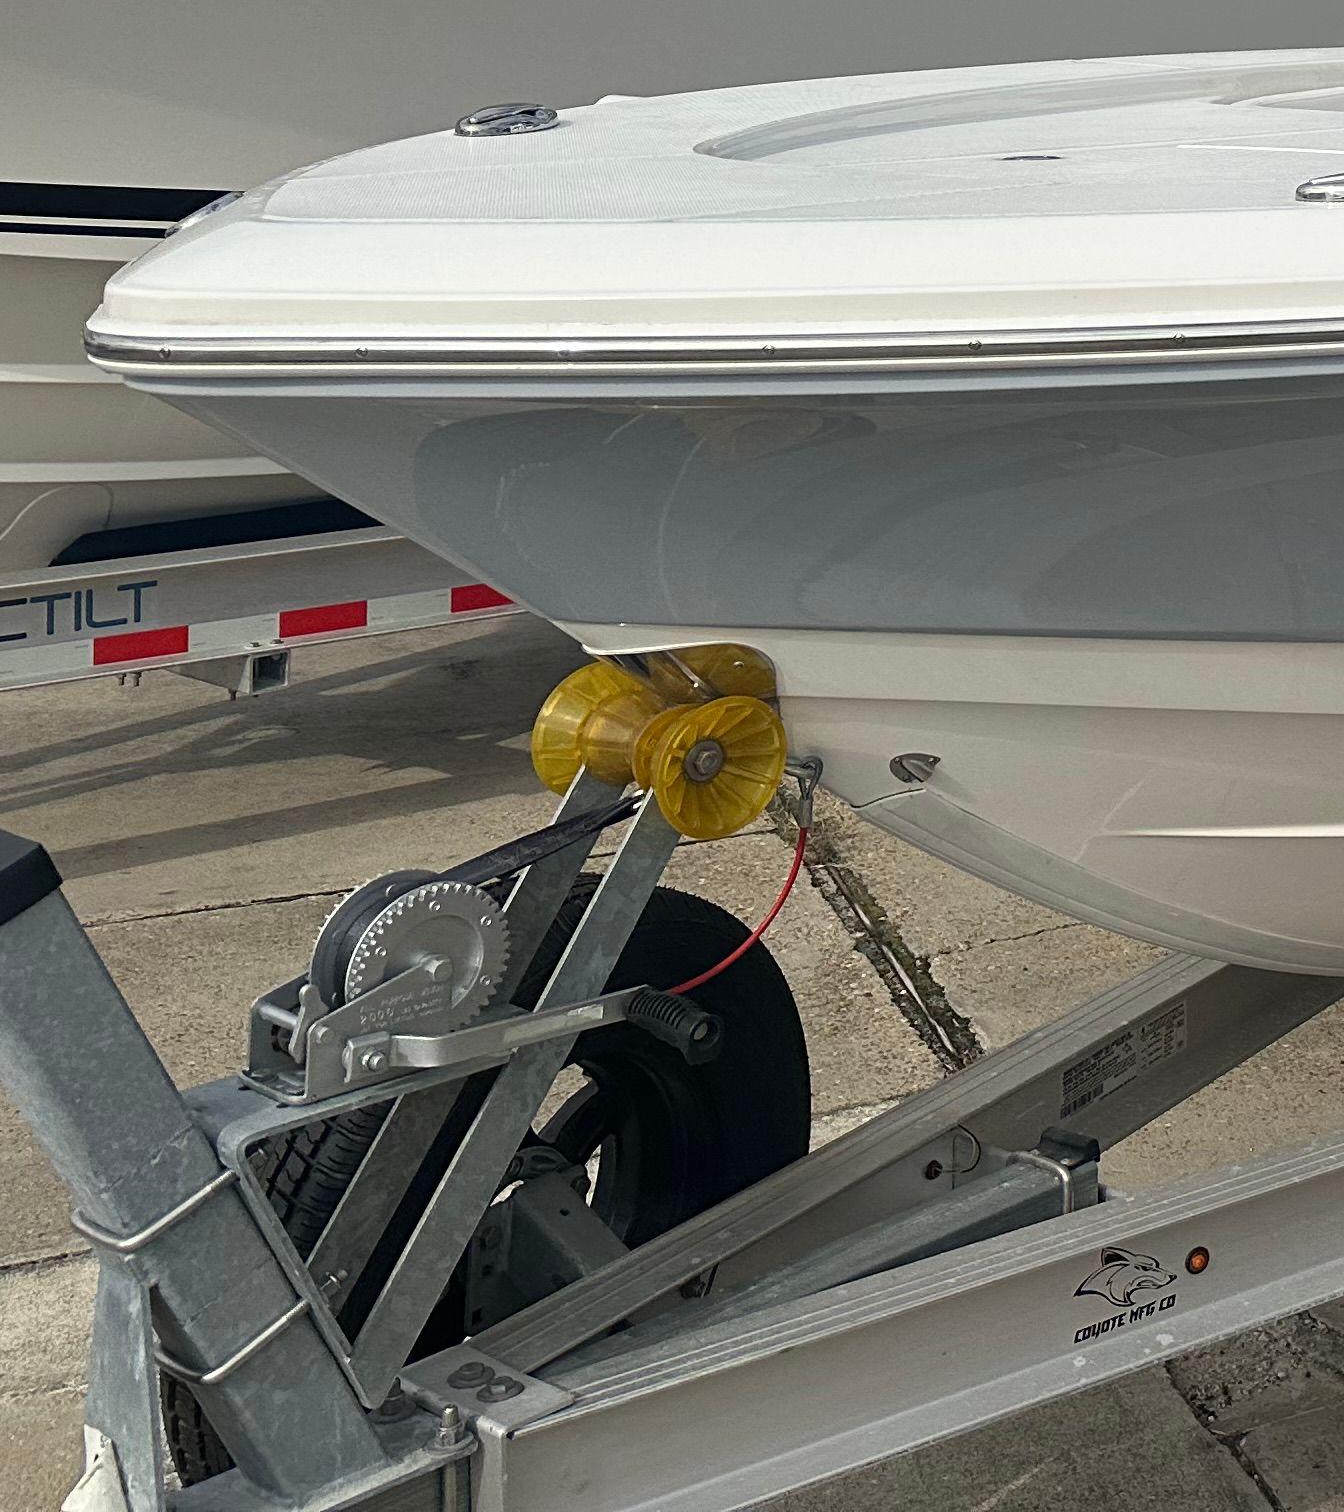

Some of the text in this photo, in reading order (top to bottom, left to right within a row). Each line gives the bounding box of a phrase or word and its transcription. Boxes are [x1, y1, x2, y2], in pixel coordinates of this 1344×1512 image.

[1073, 1293, 1177, 1344] COYOTE MFG CO
